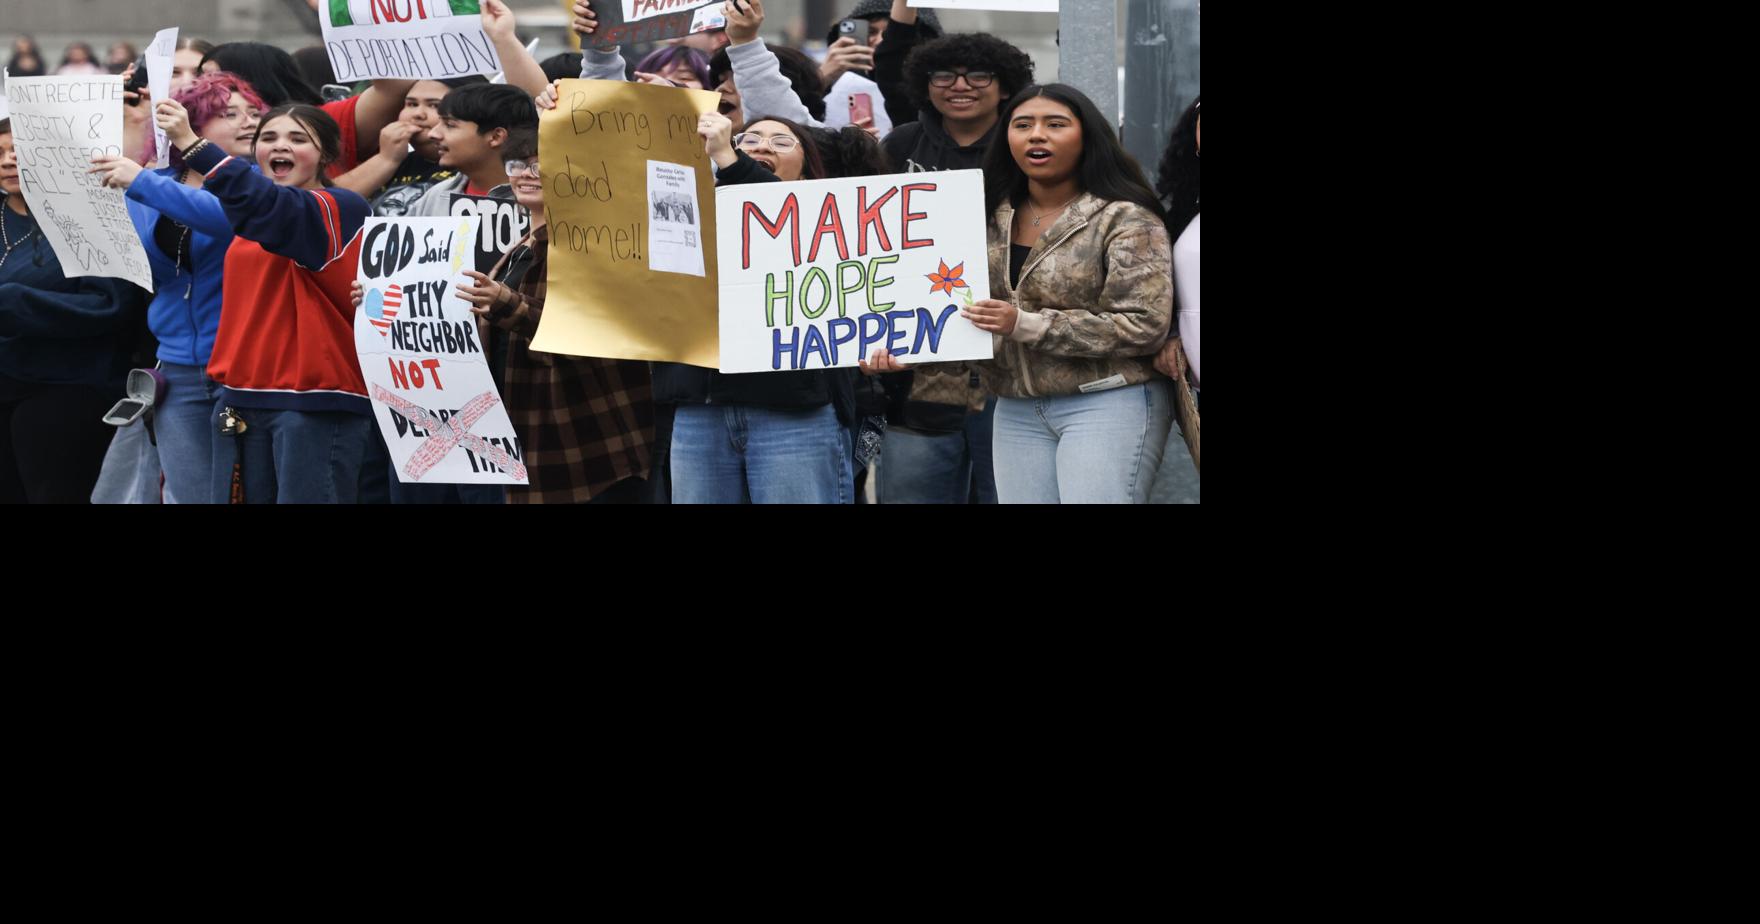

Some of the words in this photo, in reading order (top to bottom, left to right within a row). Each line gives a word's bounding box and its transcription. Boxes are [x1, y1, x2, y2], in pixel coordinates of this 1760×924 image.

[328, 30, 497, 80] DEPORTATION
[9, 84, 42, 103] ONT
[46, 82, 123, 103] RECITE
[10, 112, 75, 142] IBERTY
[88, 112, 103, 139] &
[569, 90, 650, 150] Bring
[667, 112, 701, 158] my
[16, 145, 86, 169] USTCE
[72, 171, 102, 188] EVER
[553, 155, 612, 202] dad
[547, 208, 641, 263] home!!
[742, 183, 937, 270] MAKE
[361, 222, 415, 280] GOD
[418, 228, 454, 264] Said
[403, 279, 448, 320] THY
[765, 254, 899, 327] HOPE
[391, 320, 480, 354] NEIGHBOR
[772, 304, 958, 370] HAPPEN
[388, 357, 443, 390] NOT
